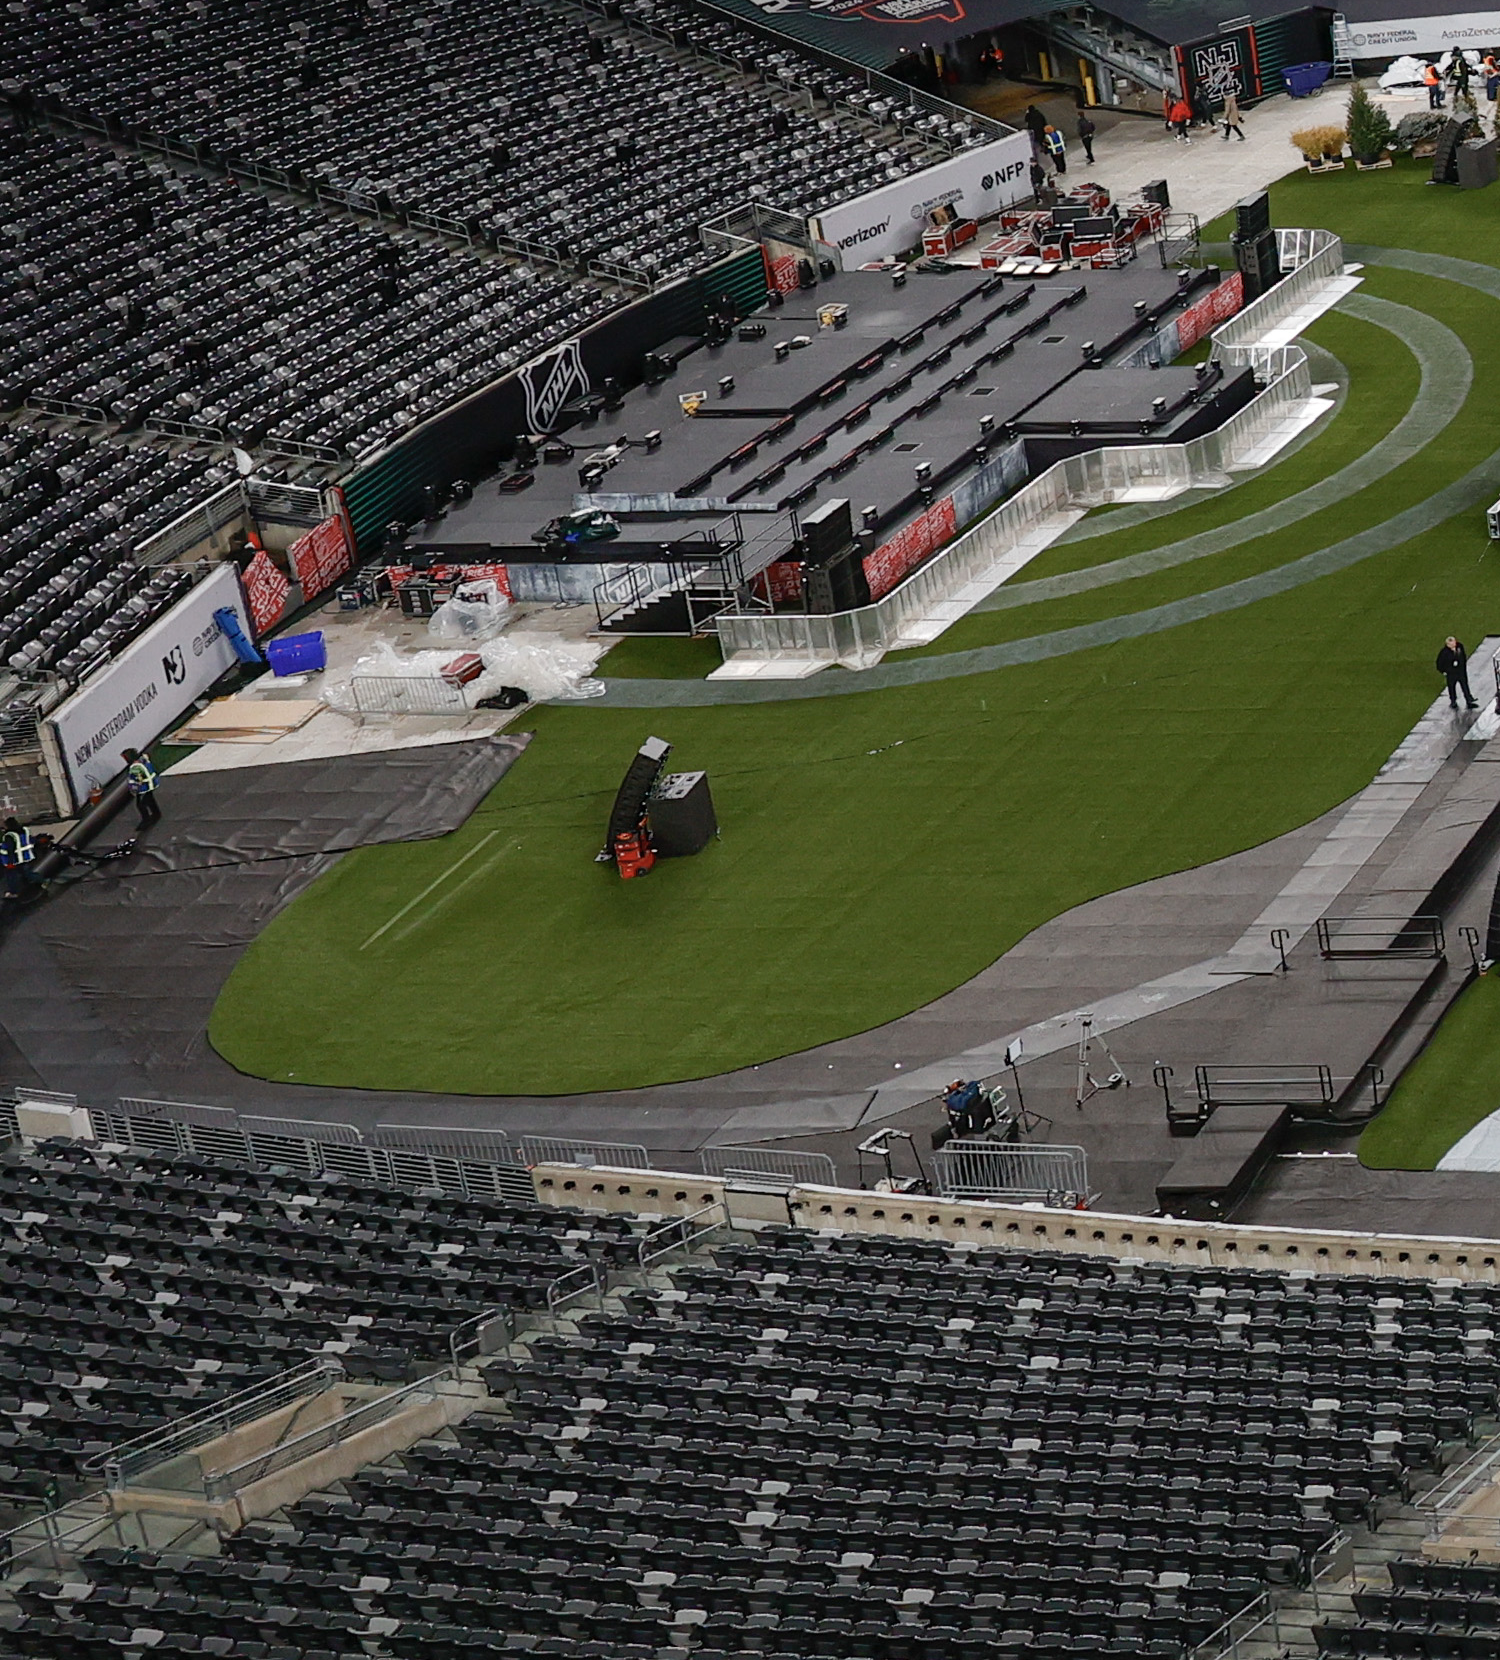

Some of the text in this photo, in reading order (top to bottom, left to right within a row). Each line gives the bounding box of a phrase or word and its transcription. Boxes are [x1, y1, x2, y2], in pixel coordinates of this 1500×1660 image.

[994, 161, 1025, 193] NFP
[837, 221, 888, 252] verizon
[541, 358, 573, 426] NHL
[73, 682, 159, 769] NEW AMSTERDAM VODKA
